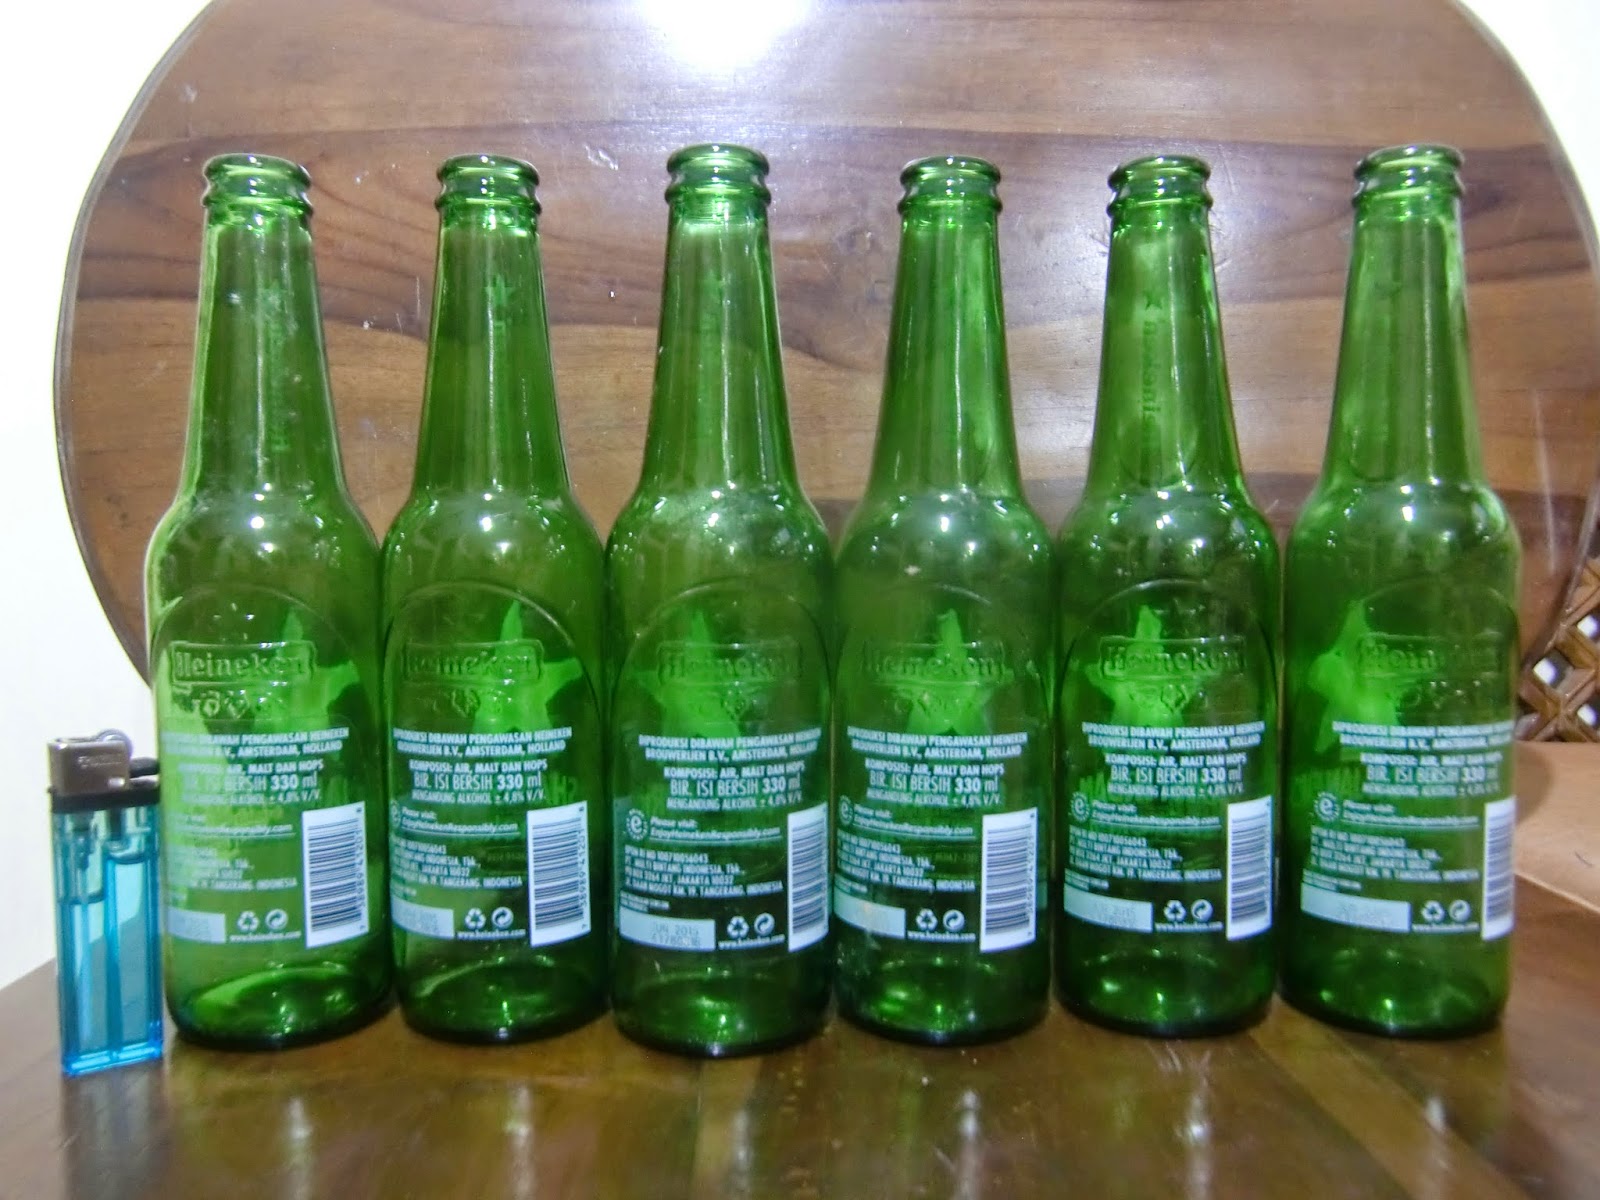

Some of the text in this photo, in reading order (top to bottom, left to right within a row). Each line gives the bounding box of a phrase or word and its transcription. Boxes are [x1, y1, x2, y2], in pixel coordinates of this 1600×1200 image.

[174, 650, 309, 678] Heineken
[241, 732, 307, 745] PENGAWASAN
[310, 728, 349, 743] HEINEKEN
[469, 731, 532, 744] PENGAWASAN
[534, 727, 572, 741] HEINEKEN
[1175, 725, 1235, 738] PENGAWASAN
[465, 744, 526, 756] AMSTERDAM,
[528, 740, 566, 753] HOLLAND
[639, 734, 689, 748] DIPRODUKSI
[691, 737, 734, 748] DIBAWAH
[737, 732, 794, 747] PENGAWASAN
[929, 734, 991, 746] PENGAWASAN
[1170, 737, 1228, 751] AMSTERDAM,
[237, 744, 299, 757] AMSTERDAM,
[302, 740, 342, 752] HOLLAND
[708, 750, 730, 762] B.V.,
[732, 746, 788, 761] AMSTERDAM,
[924, 746, 984, 760] AMSTERDAM,
[986, 744, 1022, 757] HOLLAND
[247, 762, 272, 774] MALT
[275, 761, 296, 773] DAN
[299, 759, 323, 771] HOPS
[454, 762, 472, 774] AIR,
[475, 761, 500, 773] MALT
[502, 760, 522, 772] DAN
[524, 758, 547, 771] HOPS
[1105, 753, 1157, 766] KOMPOSISI:
[1159, 755, 1178, 768] AIR,
[1180, 754, 1205, 767] MALT
[1206, 754, 1225, 766] DAN
[664, 766, 718, 778] KOMPOSISI:
[720, 767, 739, 779] AIR,
[742, 765, 765, 777] MALT
[767, 764, 785, 776] DAN
[913, 763, 932, 776] AIR,
[933, 763, 958, 775] MALT
[960, 763, 980, 775] DAN
[981, 763, 1004, 775] HOPS
[1111, 765, 1132, 782] BIR.
[1136, 767, 1152, 783] ISI
[1156, 767, 1198, 784] BERSIH
[1201, 768, 1226, 783] 330
[271, 774, 298, 790] 330
[302, 771, 317, 788] ml
[414, 771, 541, 790] BIR. ISI BERSIH 330 ml
[671, 779, 692, 796] BIR.
[697, 780, 713, 796] ISI
[718, 778, 758, 795] BERSIH
[762, 777, 786, 793] 330
[870, 770, 998, 792] BIR. ISI BERSIH 330 ml
[457, 791, 492, 804] ALKOHOL
